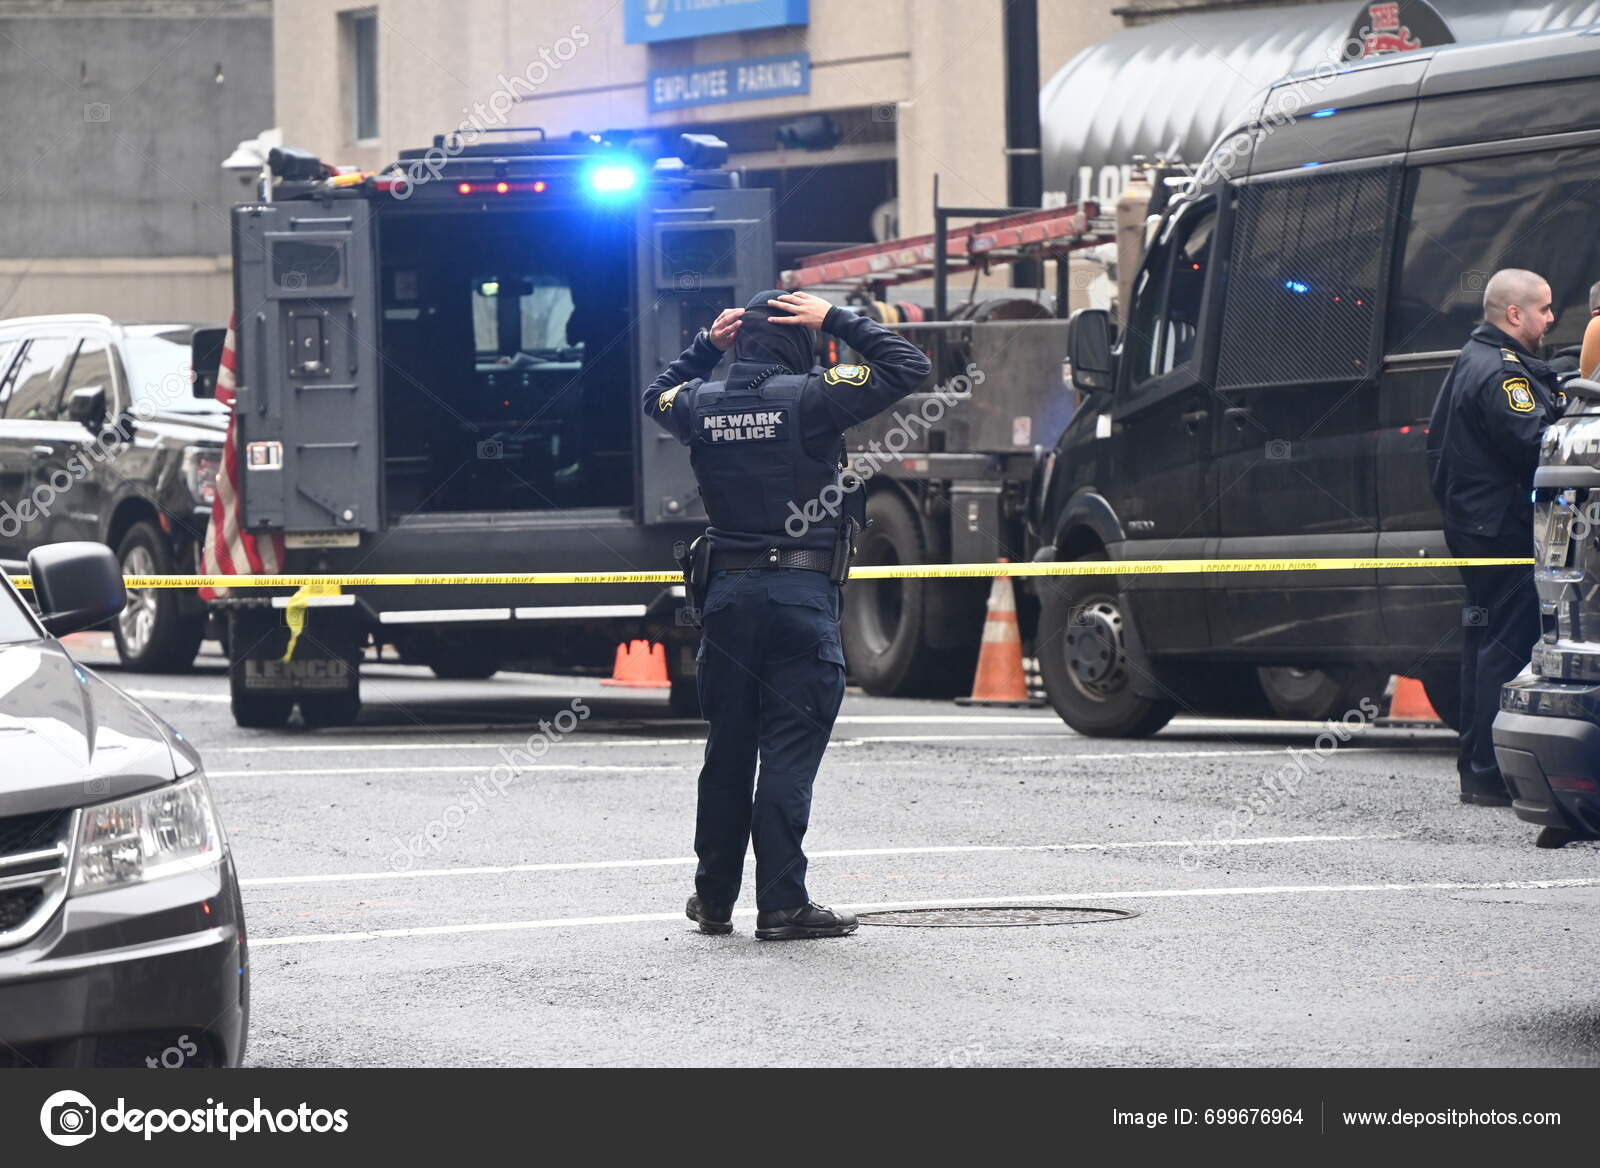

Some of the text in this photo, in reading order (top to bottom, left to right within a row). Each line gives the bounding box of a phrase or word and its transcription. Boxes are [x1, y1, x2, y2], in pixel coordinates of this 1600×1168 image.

[654, 60, 802, 104] EMPLOYEE PARKING
[703, 411, 783, 429] NEWARK
[711, 425, 776, 442] POLICE
[245, 659, 348, 678] LENCO
